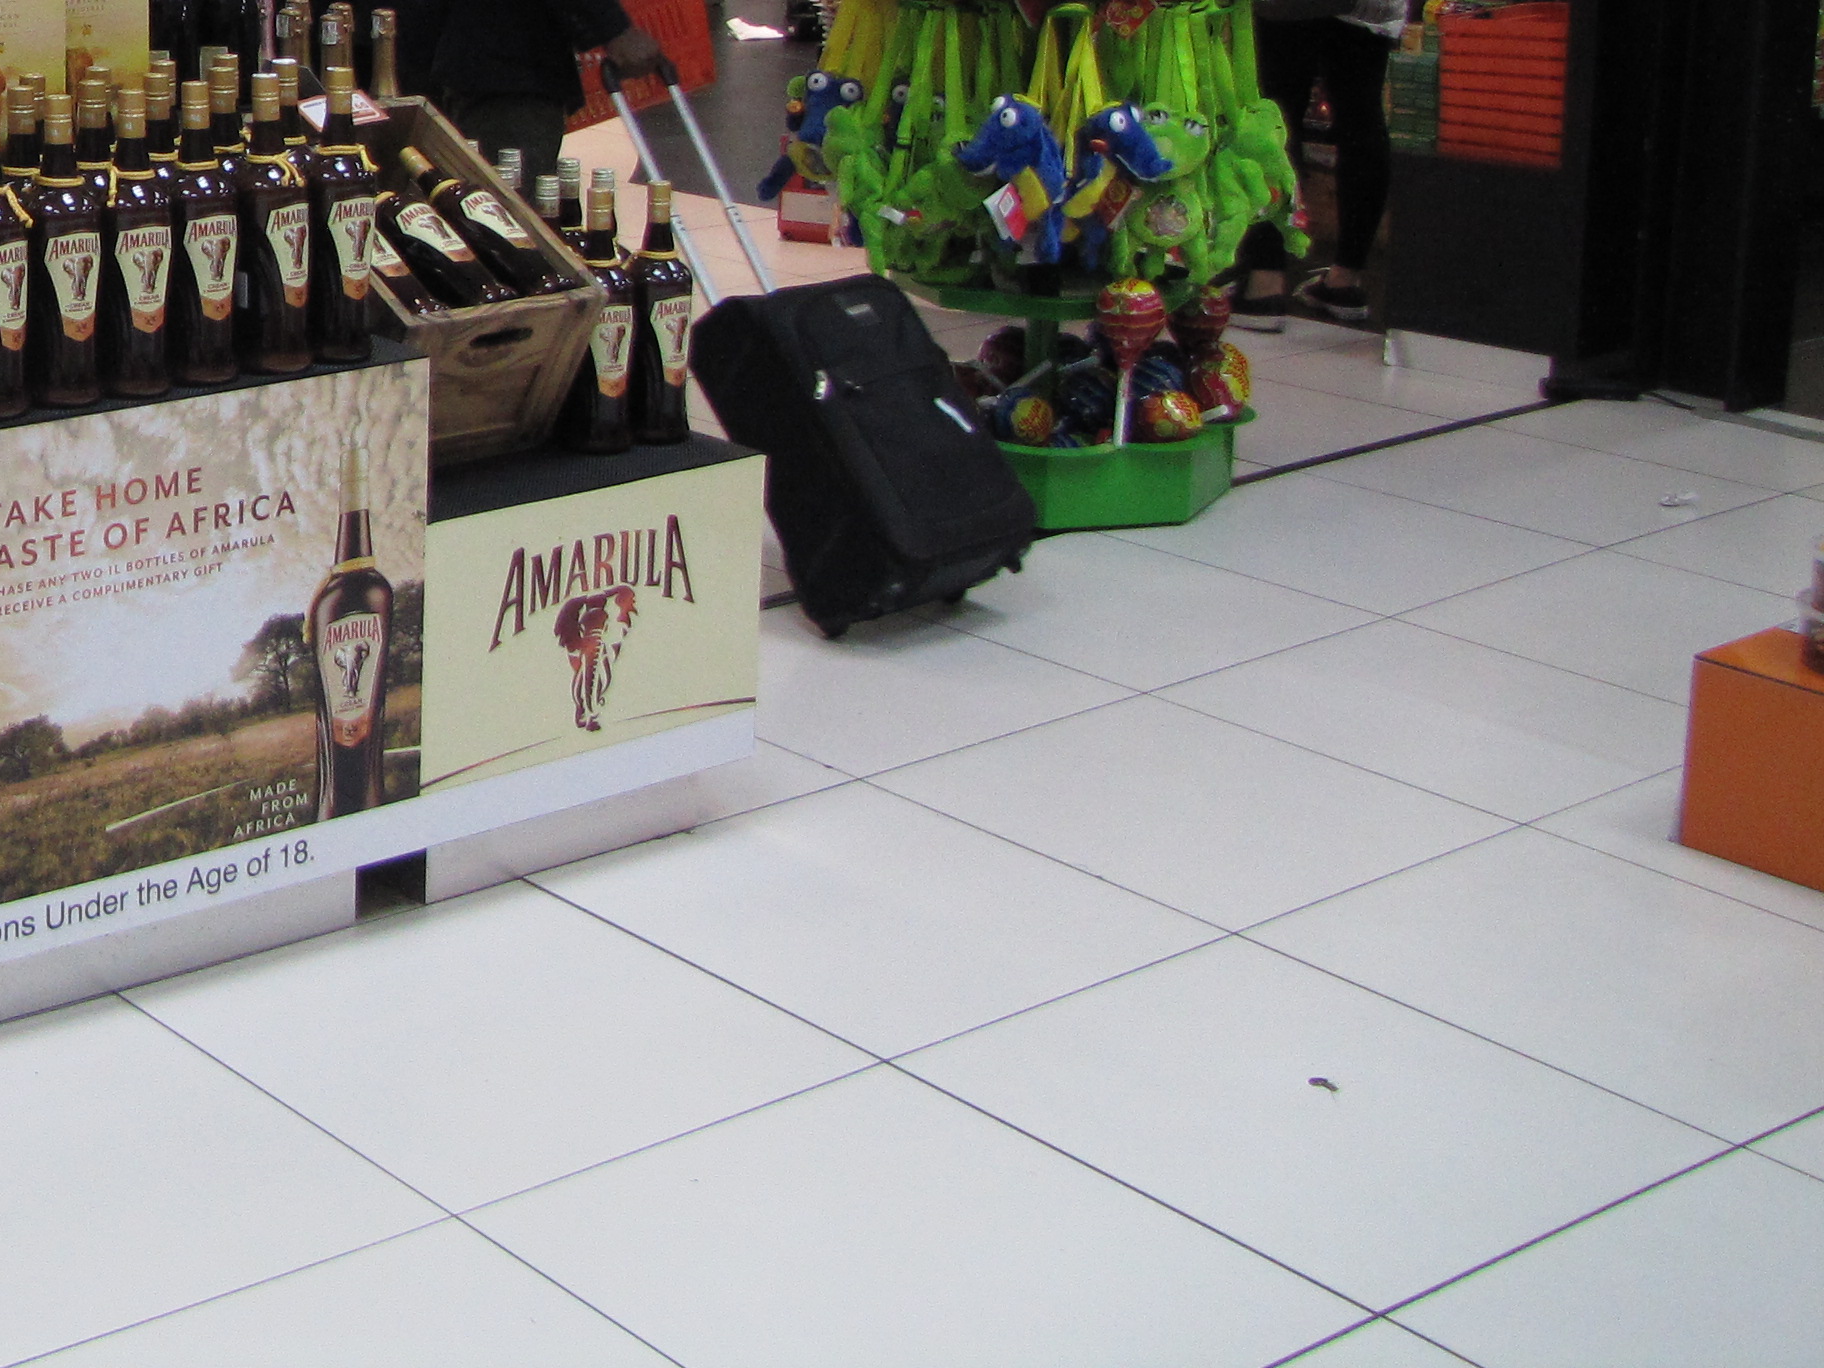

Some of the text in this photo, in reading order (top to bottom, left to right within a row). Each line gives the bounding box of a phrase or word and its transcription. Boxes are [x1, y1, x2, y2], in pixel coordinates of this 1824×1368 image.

[48, 234, 100, 262] AMARULA
[119, 228, 172, 254] AMARULA
[95, 466, 203, 511] HOME
[103, 517, 150, 550] OF
[166, 490, 297, 539] AFRICA
[38, 574, 67, 590] ANY
[71, 567, 103, 583] TWO
[126, 551, 185, 572] BOTTLES
[189, 548, 208, 560] OF
[212, 534, 276, 555] AMARULA
[58, 592, 67, 604] A
[72, 568, 189, 601] COMPLIMENTARY
[194, 561, 224, 578] GIFT
[489, 514, 695, 653] AMARULA
[322, 616, 383, 654] AMARULA
[249, 778, 297, 800] MADE
[261, 793, 308, 814] FROM
[232, 812, 295, 838] AFRICA
[45, 889, 129, 930] Under
[137, 878, 177, 906] the
[186, 862, 237, 894] Age
[246, 847, 272, 877] of
[280, 839, 314, 868] 18.
